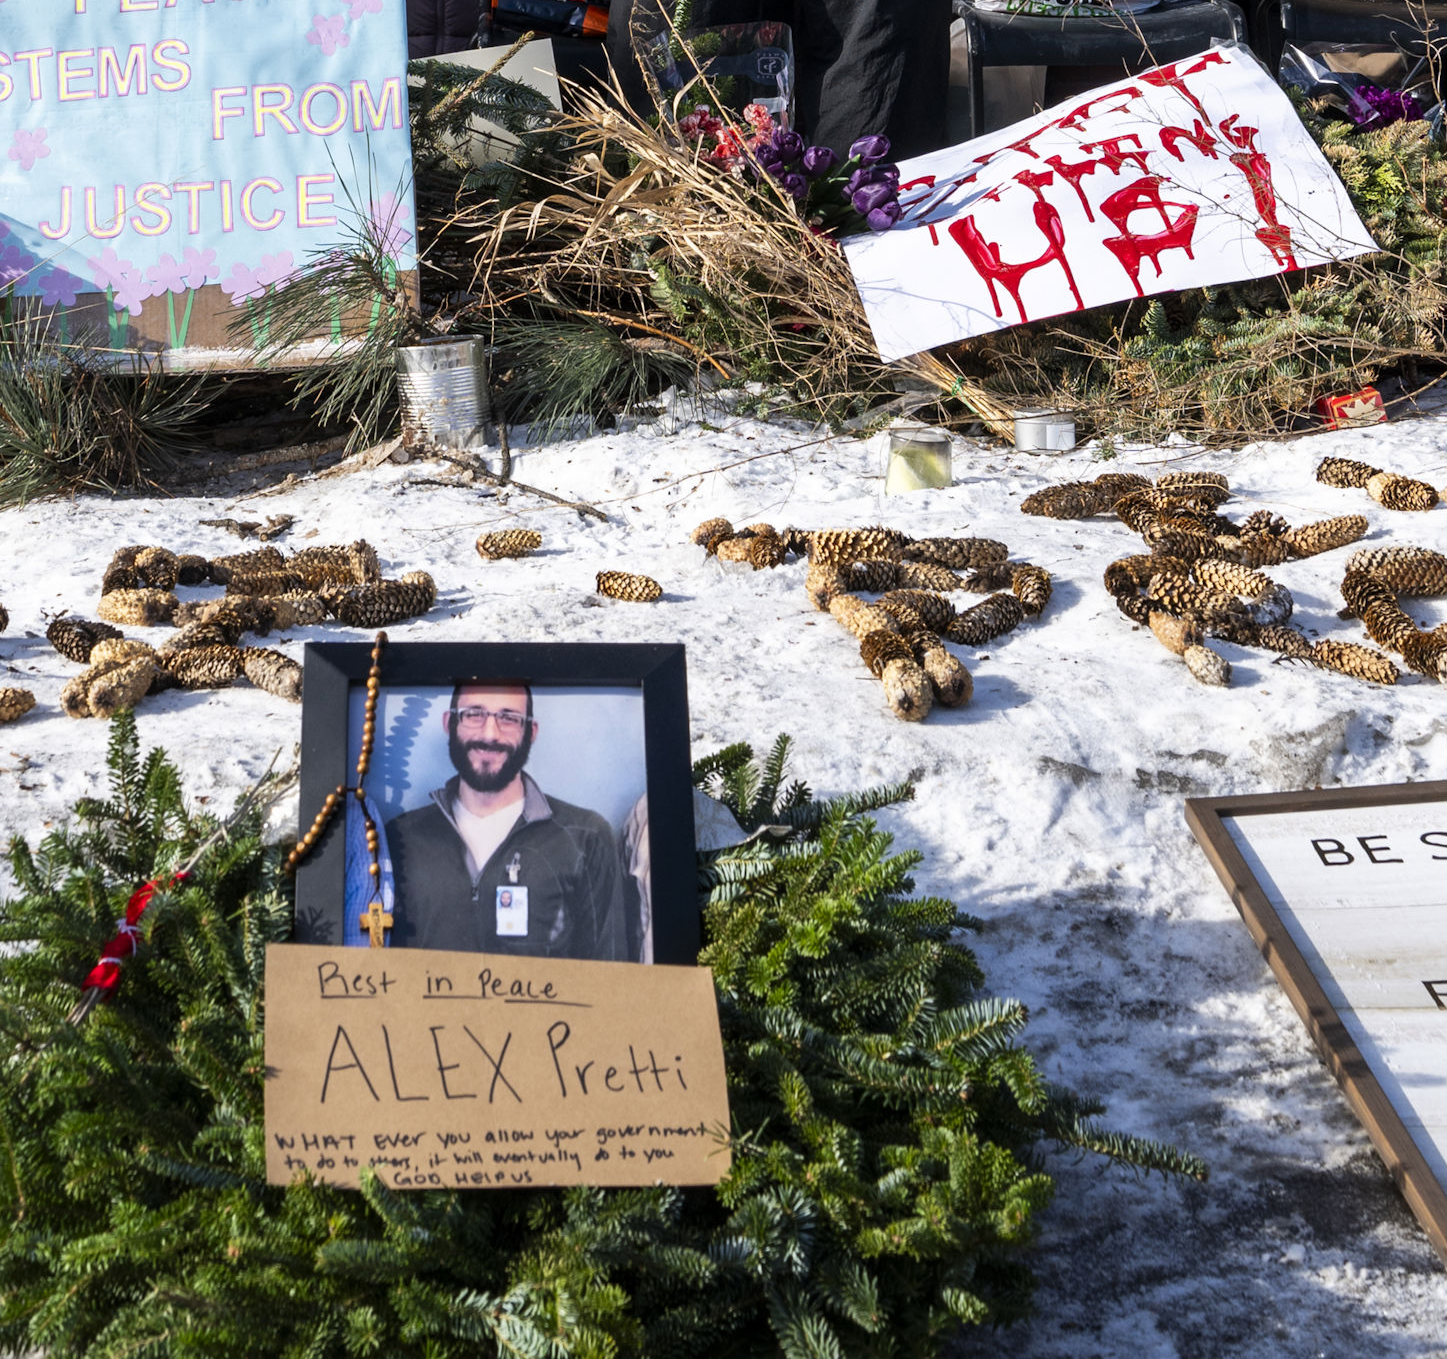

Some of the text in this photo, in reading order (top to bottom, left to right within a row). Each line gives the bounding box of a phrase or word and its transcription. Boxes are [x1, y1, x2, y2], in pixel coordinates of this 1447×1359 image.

[212, 77, 404, 141] FROM
[38, 173, 338, 240] JUSTICE
[1309, 835, 1404, 869] BE
[425, 970, 453, 994] in
[320, 1020, 688, 1104] ALEX Pretti
[484, 1129, 534, 1143] allow
[545, 1128, 585, 1148] your
[285, 1154, 306, 1170] to
[316, 1154, 336, 1169] do
[343, 1155, 359, 1168] to
[429, 1154, 448, 1169] it
[454, 1150, 483, 1164] will
[493, 1148, 583, 1172] eventually
[594, 1148, 610, 1162] do
[619, 1145, 636, 1160] to
[644, 1148, 675, 1164] you
